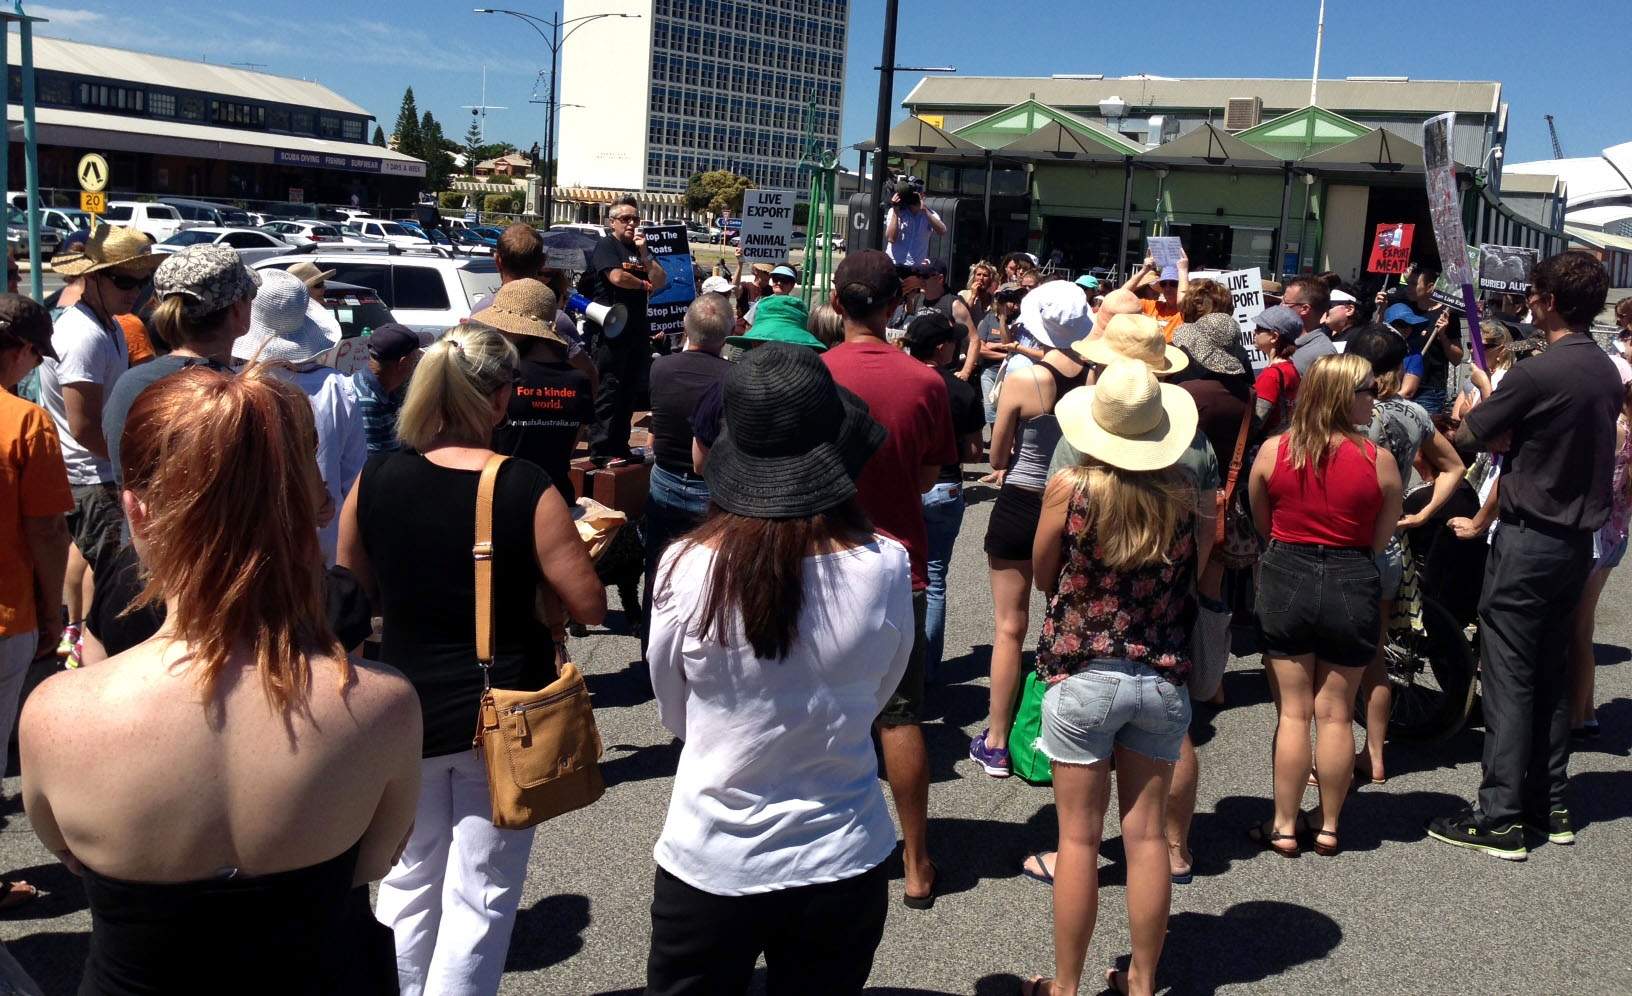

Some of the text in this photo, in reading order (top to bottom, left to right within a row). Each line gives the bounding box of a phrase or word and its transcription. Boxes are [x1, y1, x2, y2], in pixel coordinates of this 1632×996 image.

[281, 152, 379, 169] SCUBA DIVING FISHING SURFWEAR
[86, 194, 100, 206] 20
[758, 193, 782, 205] LIVE
[747, 206, 791, 219] EXPORT
[645, 231, 678, 242] top The
[745, 234, 787, 247] ANIMAL
[743, 247, 787, 259] CRUELTY
[1228, 274, 1249, 291] LIVE
[1480, 277, 1532, 291] BURIED ALIV
[1232, 291, 1260, 308] PORT
[1455, 299, 1466, 308] Exp
[647, 304, 689, 317] Stop Live
[650, 320, 685, 332] Exports
[517, 386, 577, 398] For a kinder
[532, 400, 564, 409] world.
